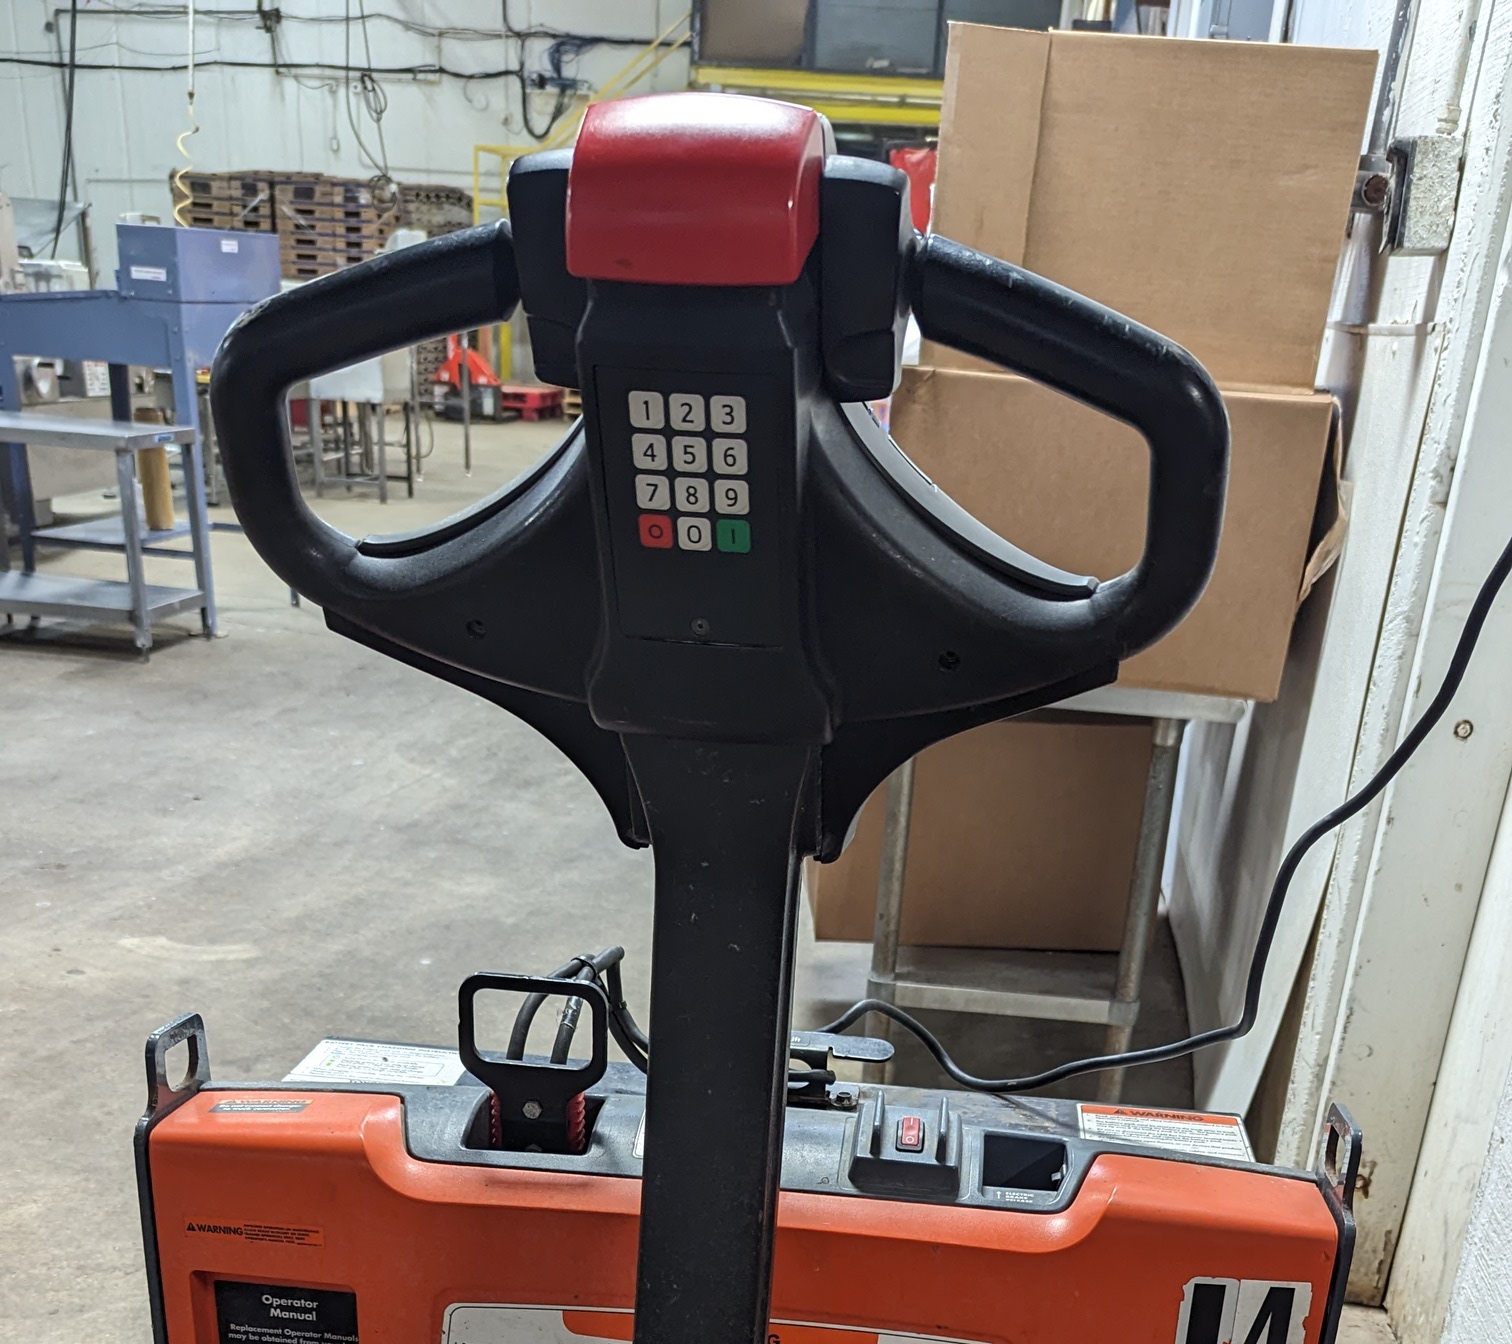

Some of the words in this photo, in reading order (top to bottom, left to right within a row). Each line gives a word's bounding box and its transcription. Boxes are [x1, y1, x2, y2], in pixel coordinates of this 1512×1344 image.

[642, 400, 650, 421] 1
[680, 402, 694, 424] 2
[721, 404, 735, 425] 3
[643, 443, 657, 462] 4
[683, 445, 696, 465] 5
[723, 447, 736, 467] 6
[646, 483, 658, 502] 7
[686, 485, 699, 505] 8
[725, 488, 738, 507] 9
[687, 525, 701, 544] 0
[1129, 1110, 1204, 1122] WARNING
[197, 1224, 244, 1236] WARNING
[261, 1294, 319, 1309] Operator
[270, 1307, 317, 1321] Manual
[228, 1333, 247, 1341] may
[249, 1333, 259, 1341] be
[261, 1335, 298, 1344] obtained
[230, 1323, 282, 1335] Replacement
[284, 1328, 322, 1339] Operator
[323, 1332, 359, 1342] Manuals
